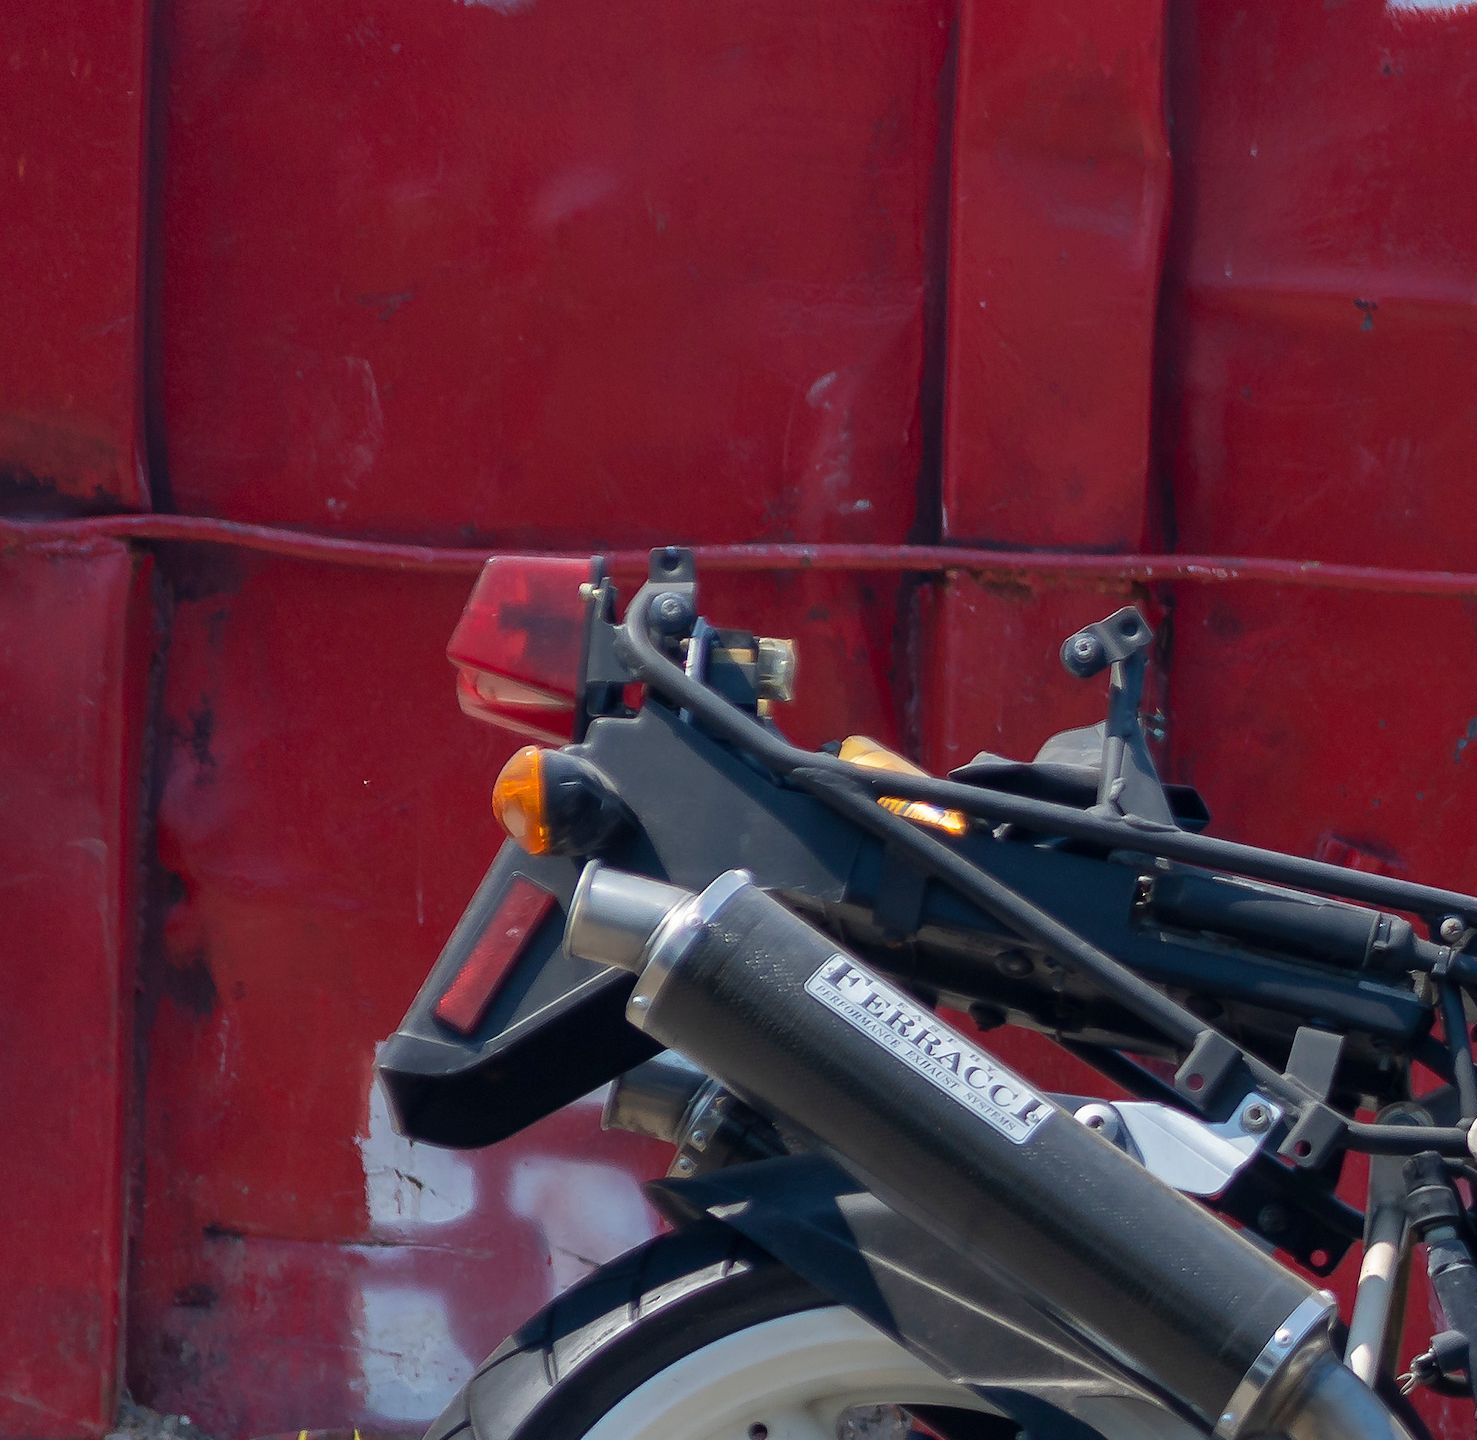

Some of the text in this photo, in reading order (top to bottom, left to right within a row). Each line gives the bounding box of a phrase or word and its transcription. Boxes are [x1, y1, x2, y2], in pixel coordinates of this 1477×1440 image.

[815, 984, 1017, 1132] PERFORMANCE EXHAUST SYSTEMS
[822, 959, 1045, 1127] FERRACCI
